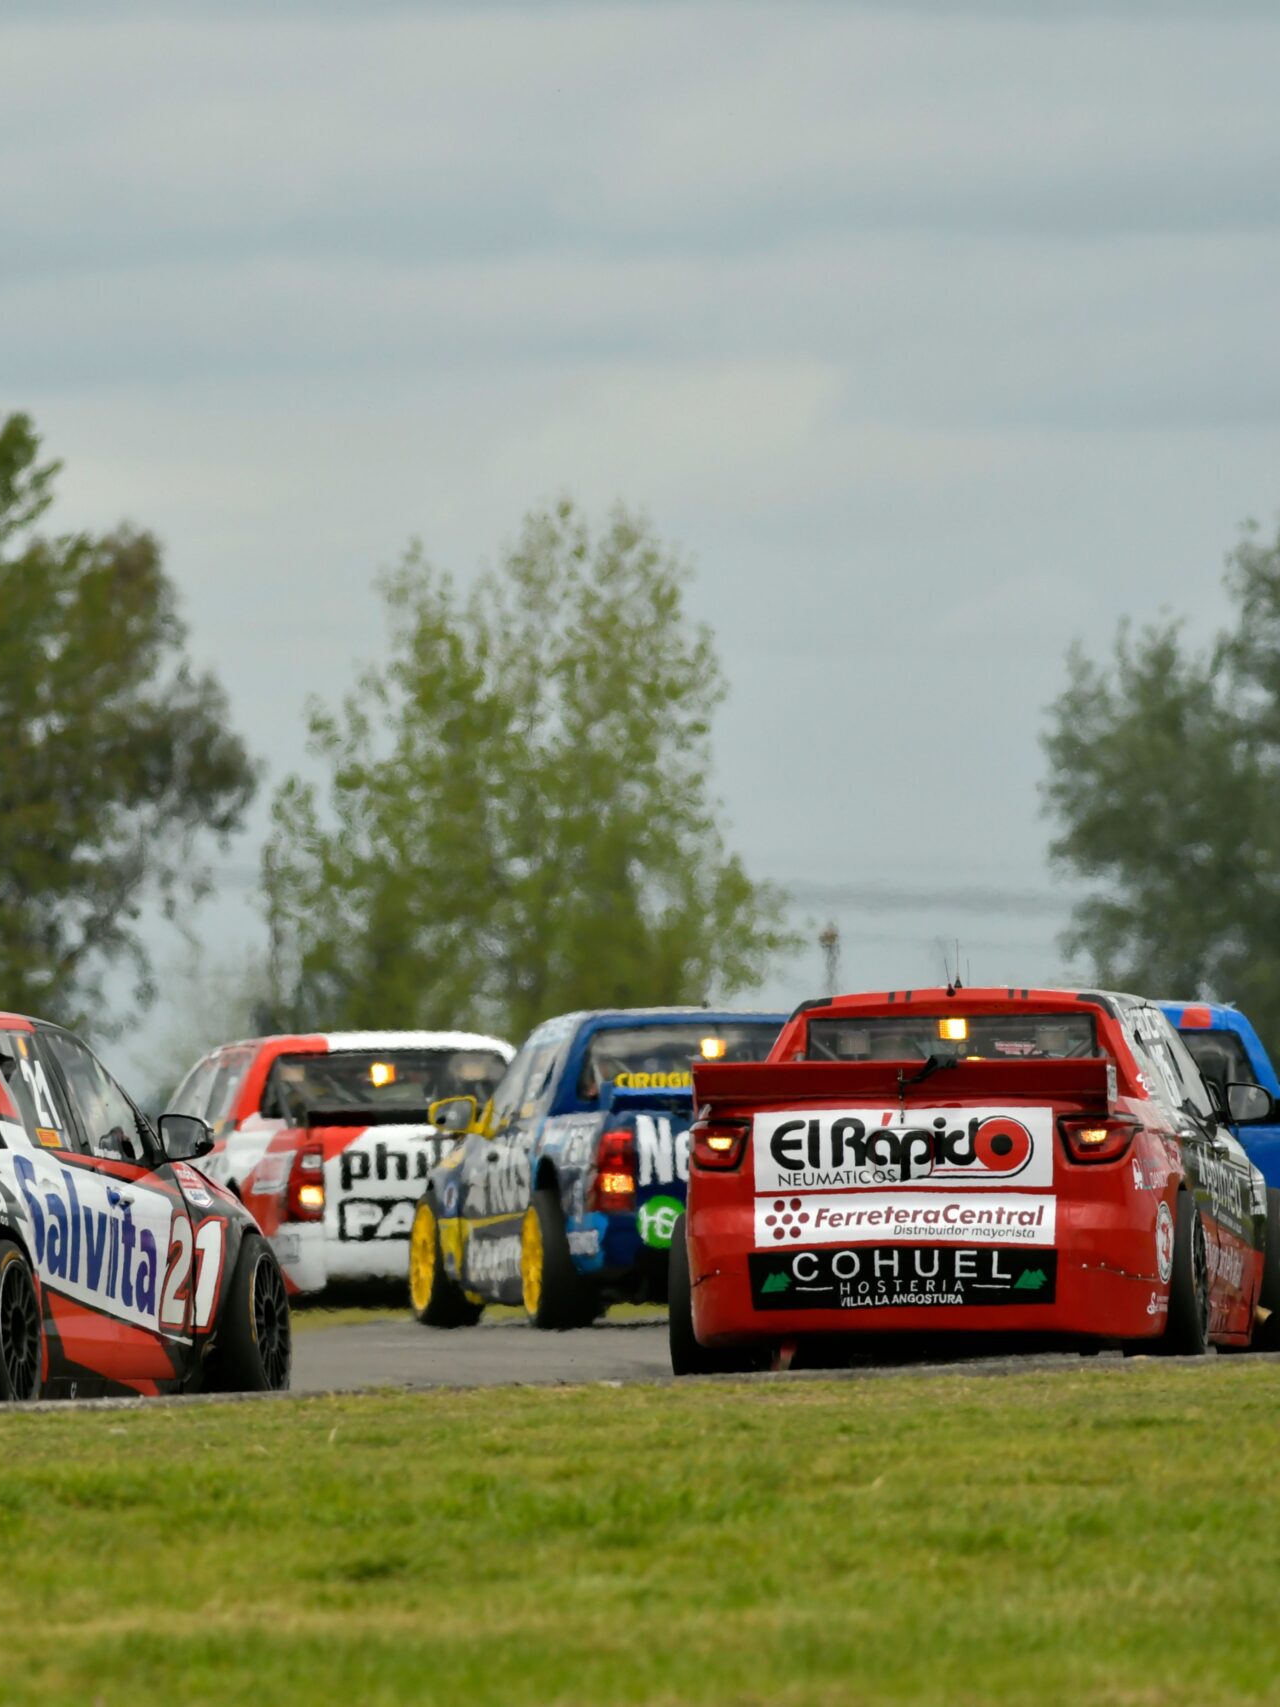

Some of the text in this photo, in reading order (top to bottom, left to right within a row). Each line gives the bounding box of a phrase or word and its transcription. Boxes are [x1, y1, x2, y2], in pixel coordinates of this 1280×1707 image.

[20, 1060, 63, 1129] 21
[770, 1119, 821, 1170] El
[778, 1168, 897, 1187] NEUMATICOS
[13, 1154, 156, 1317] Salvita
[893, 1224, 1036, 1239] Distribuidor mayorista
[160, 1209, 226, 1332] 21
[792, 1249, 1012, 1282] COHUEL
[839, 1279, 965, 1296] HOSTERIA
[840, 1292, 963, 1308] VILLA LA ANGOSTURA
